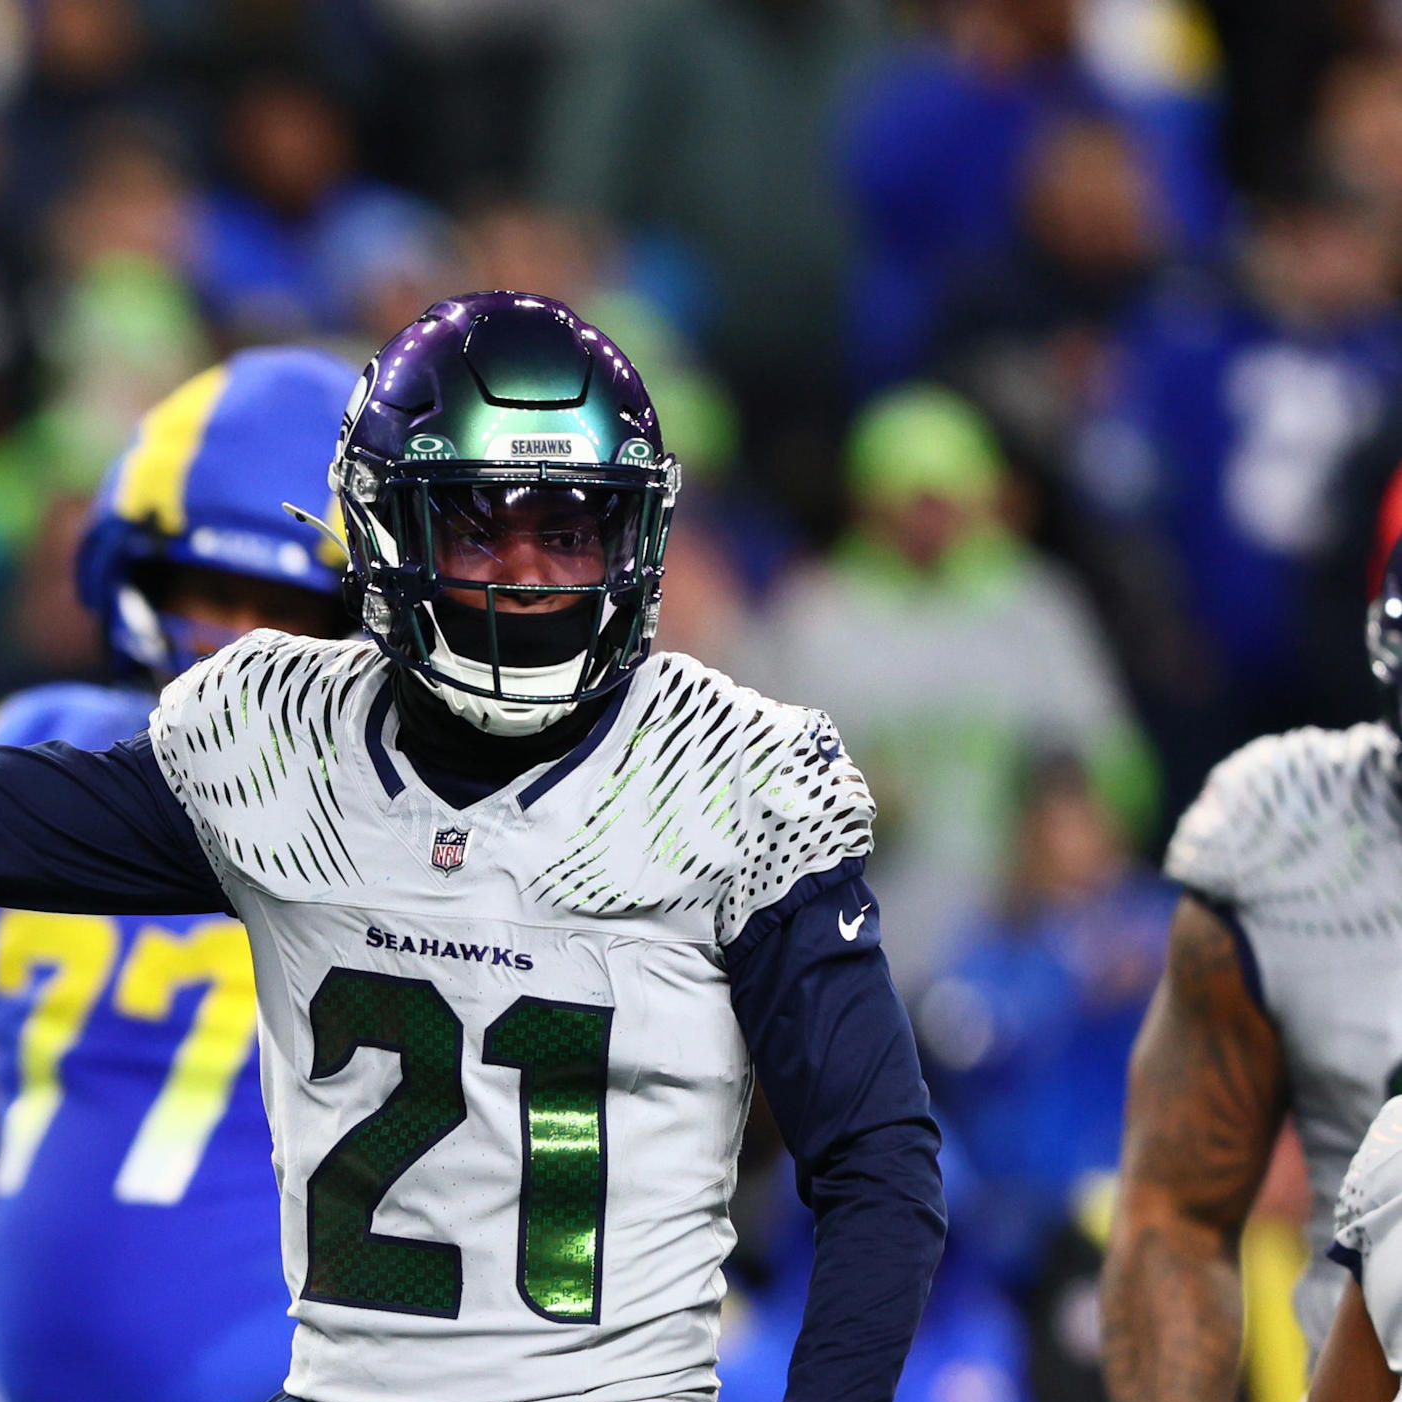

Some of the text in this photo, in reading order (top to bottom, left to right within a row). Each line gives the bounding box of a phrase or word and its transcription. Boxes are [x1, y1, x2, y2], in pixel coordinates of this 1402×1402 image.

[511, 440, 572, 454] SEAHAWKS
[435, 846, 462, 866] NFL
[366, 926, 534, 971] SEAHAWKS
[300, 966, 614, 1325] 21
